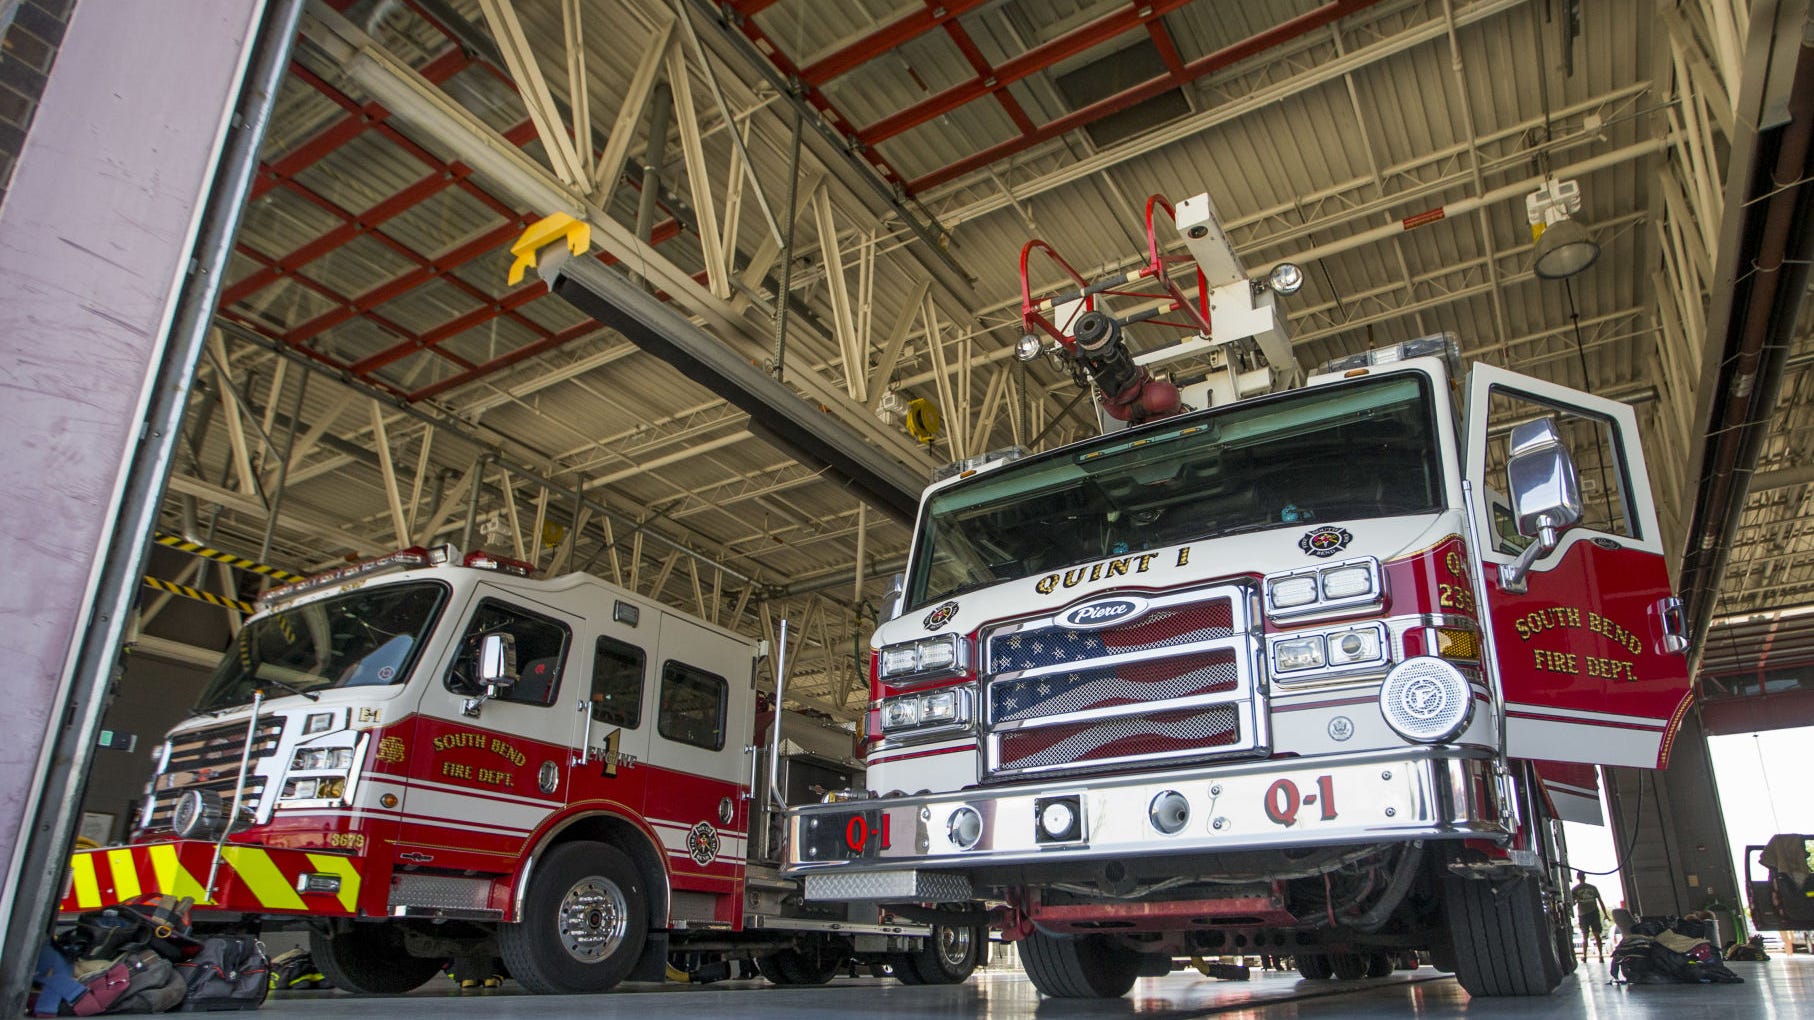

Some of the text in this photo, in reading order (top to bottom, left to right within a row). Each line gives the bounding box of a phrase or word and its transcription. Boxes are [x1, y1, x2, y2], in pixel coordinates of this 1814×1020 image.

[1035, 552, 1160, 595] QUINT
[1074, 603, 1128, 624] Pierce
[1515, 607, 1642, 655] SOUTH BEND
[1533, 648, 1638, 681] FIRE DEPT.
[433, 732, 486, 752] SOUTH
[490, 738, 527, 767] BEND
[588, 745, 638, 769] ENGINE
[602, 728, 621, 778] 1
[442, 761, 515, 787] FIRE DEPT.
[1264, 775, 1338, 828] Q-1
[845, 813, 892, 854] Q-1
